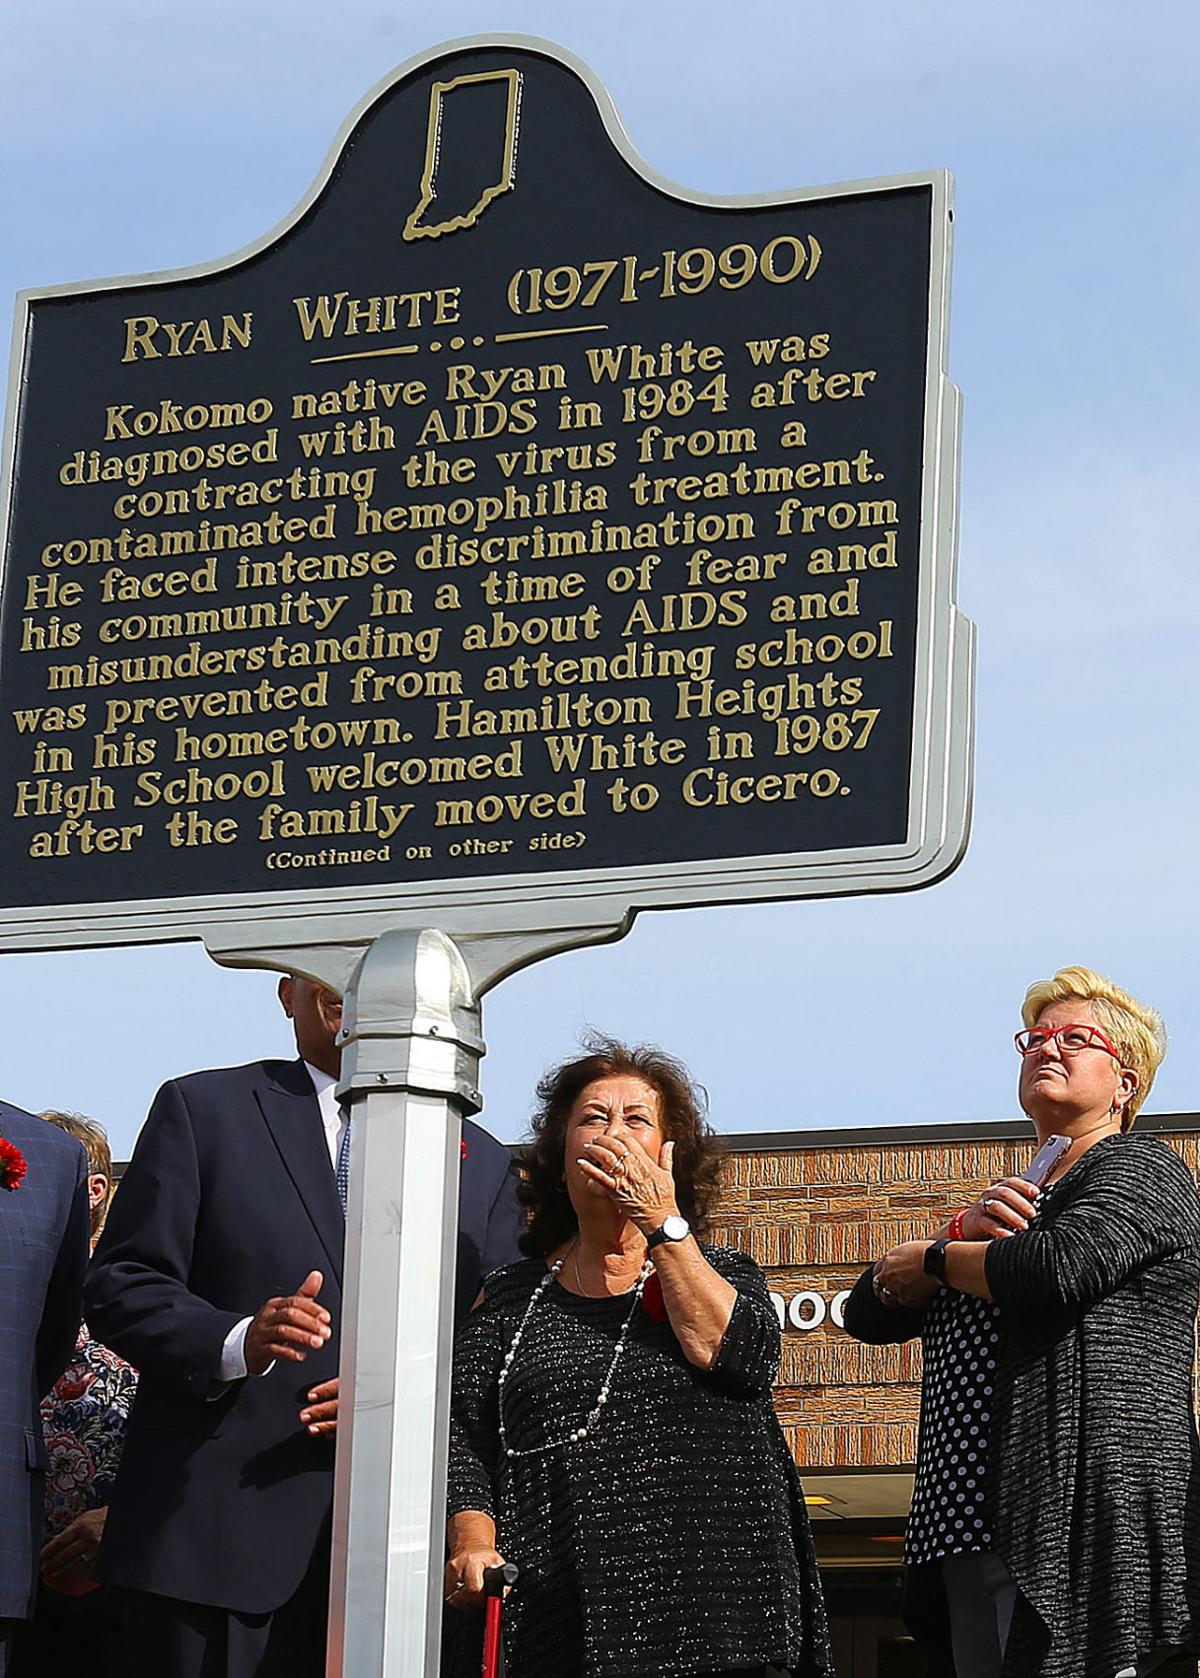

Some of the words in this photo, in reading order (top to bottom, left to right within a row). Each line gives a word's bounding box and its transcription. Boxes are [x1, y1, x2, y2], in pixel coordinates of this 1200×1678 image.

[120, 312, 254, 363] RYAN
[292, 286, 462, 341] WHITE
[507, 234, 823, 315] (1971-1990)
[59, 427, 279, 487] diagnosed
[298, 415, 396, 458] with
[415, 398, 538, 446] AIDS
[558, 395, 604, 430] in
[622, 373, 730, 423] 1984
[750, 367, 877, 409] after
[103, 398, 274, 441] Kokomo
[290, 378, 428, 419] native
[445, 363, 568, 402] Ryan
[584, 340, 725, 384] White
[745, 333, 831, 366] was
[41, 503, 337, 568] contaminated
[354, 478, 609, 535] hemophilia
[628, 449, 885, 506] treatment.
[113, 466, 378, 520] contracting
[401, 449, 477, 488] the
[495, 441, 617, 478] virus
[636, 425, 758, 463] from
[780, 421, 807, 448] a
[19, 617, 82, 653] his
[99, 590, 350, 643] community
[369, 582, 414, 617] in
[434, 583, 462, 610] a
[480, 570, 587, 605] time
[606, 554, 662, 593] of
[685, 548, 788, 586] fear
[807, 530, 898, 575] and
[23, 572, 85, 611] He
[99, 556, 218, 603] faced
[235, 550, 398, 589] intense
[415, 510, 756, 570] discrimination
[774, 497, 900, 536] from
[12, 703, 87, 734] was
[102, 670, 329, 735] prevented
[349, 666, 464, 704] from
[483, 641, 716, 692] attending
[735, 620, 894, 670] school
[47, 623, 443, 690] misunderstanding
[462, 605, 602, 651] about
[621, 589, 748, 637] AIDS
[769, 577, 860, 623] and
[13, 775, 116, 820] High
[133, 759, 286, 807] School
[305, 739, 524, 793] welcomed
[543, 731, 687, 773] White
[706, 725, 755, 761] in
[774, 708, 882, 756] 1987
[32, 740, 74, 774] in
[92, 731, 158, 769] his
[174, 715, 414, 762] hometown.
[433, 692, 653, 740] Hamilton
[675, 671, 864, 722] Heights
[29, 819, 144, 858] after
[164, 810, 239, 847] the
[258, 795, 416, 841] family
[434, 778, 587, 826] moved
[606, 777, 660, 813] to
[682, 766, 851, 807] Cicero.
[266, 845, 391, 870] (Continued
[405, 846, 433, 860] on
[449, 838, 514, 857] other
[528, 831, 587, 851] side)
